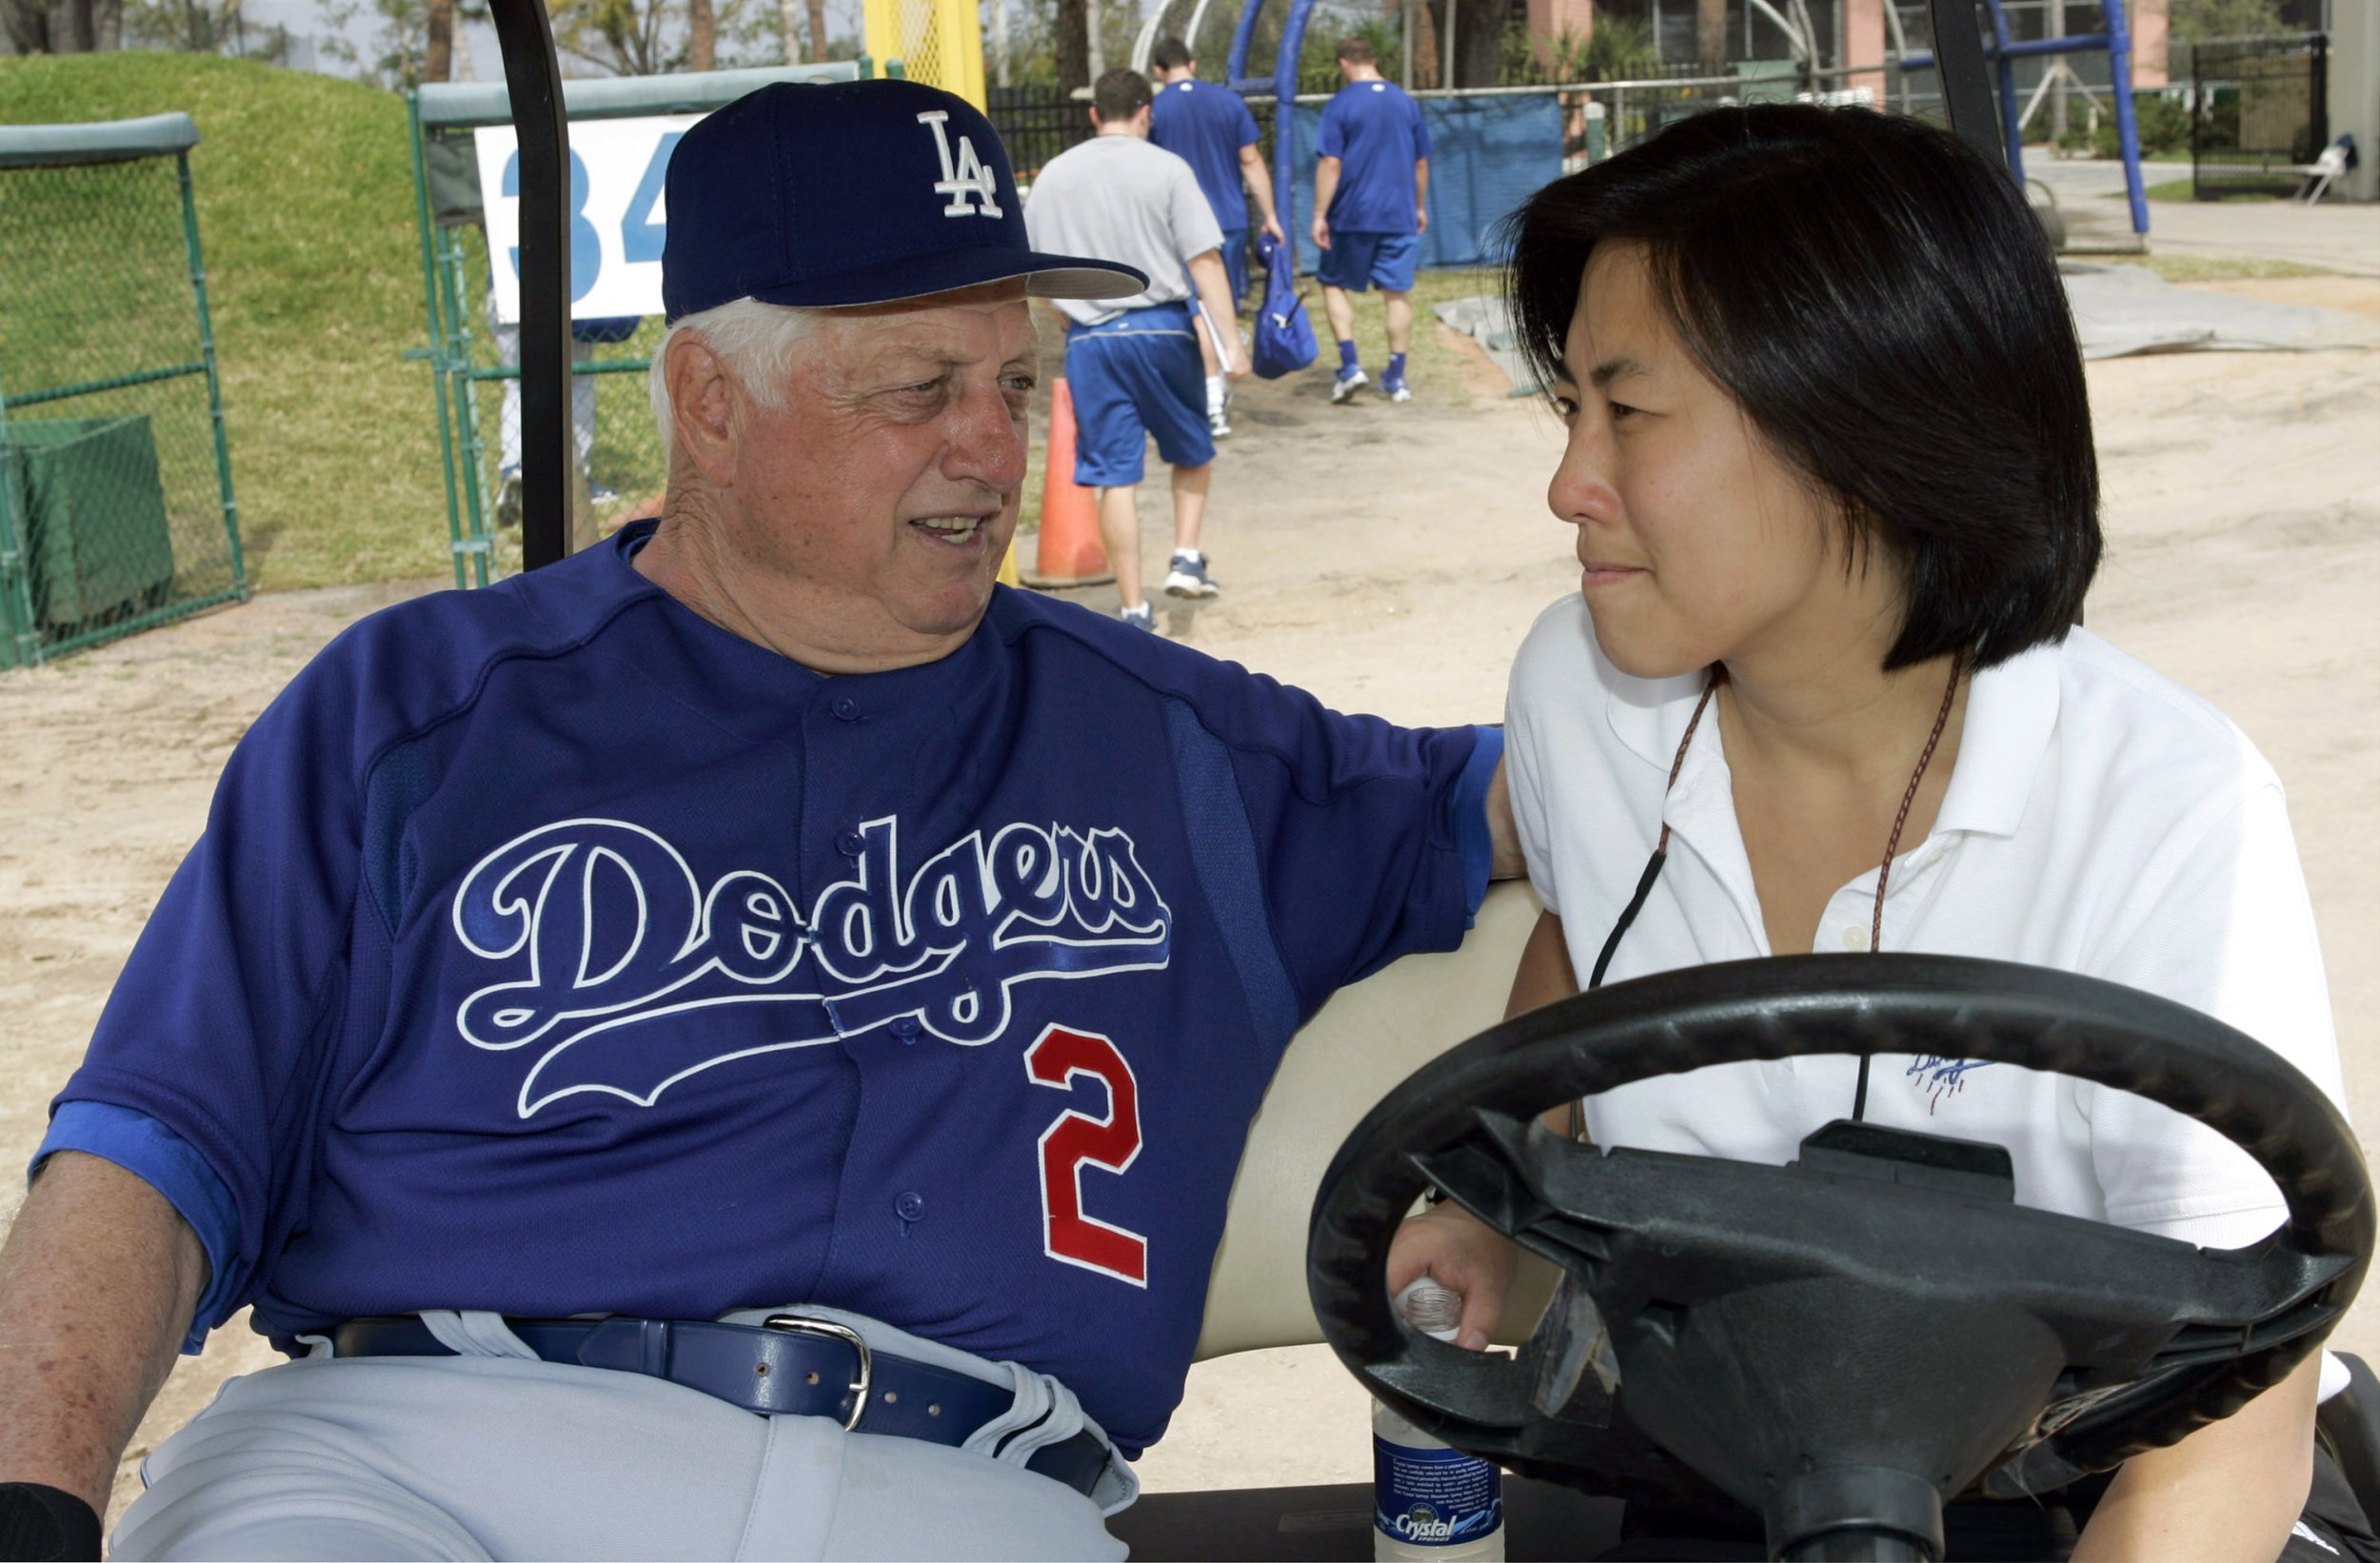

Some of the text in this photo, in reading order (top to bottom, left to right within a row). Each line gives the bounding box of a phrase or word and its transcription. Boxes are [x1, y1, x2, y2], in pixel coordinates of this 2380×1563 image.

[916, 109, 1002, 219] LA
[452, 815, 1171, 1046] Dodgers
[1023, 1022, 1147, 1288] 2
[1396, 1514, 1457, 1541] Crystal
